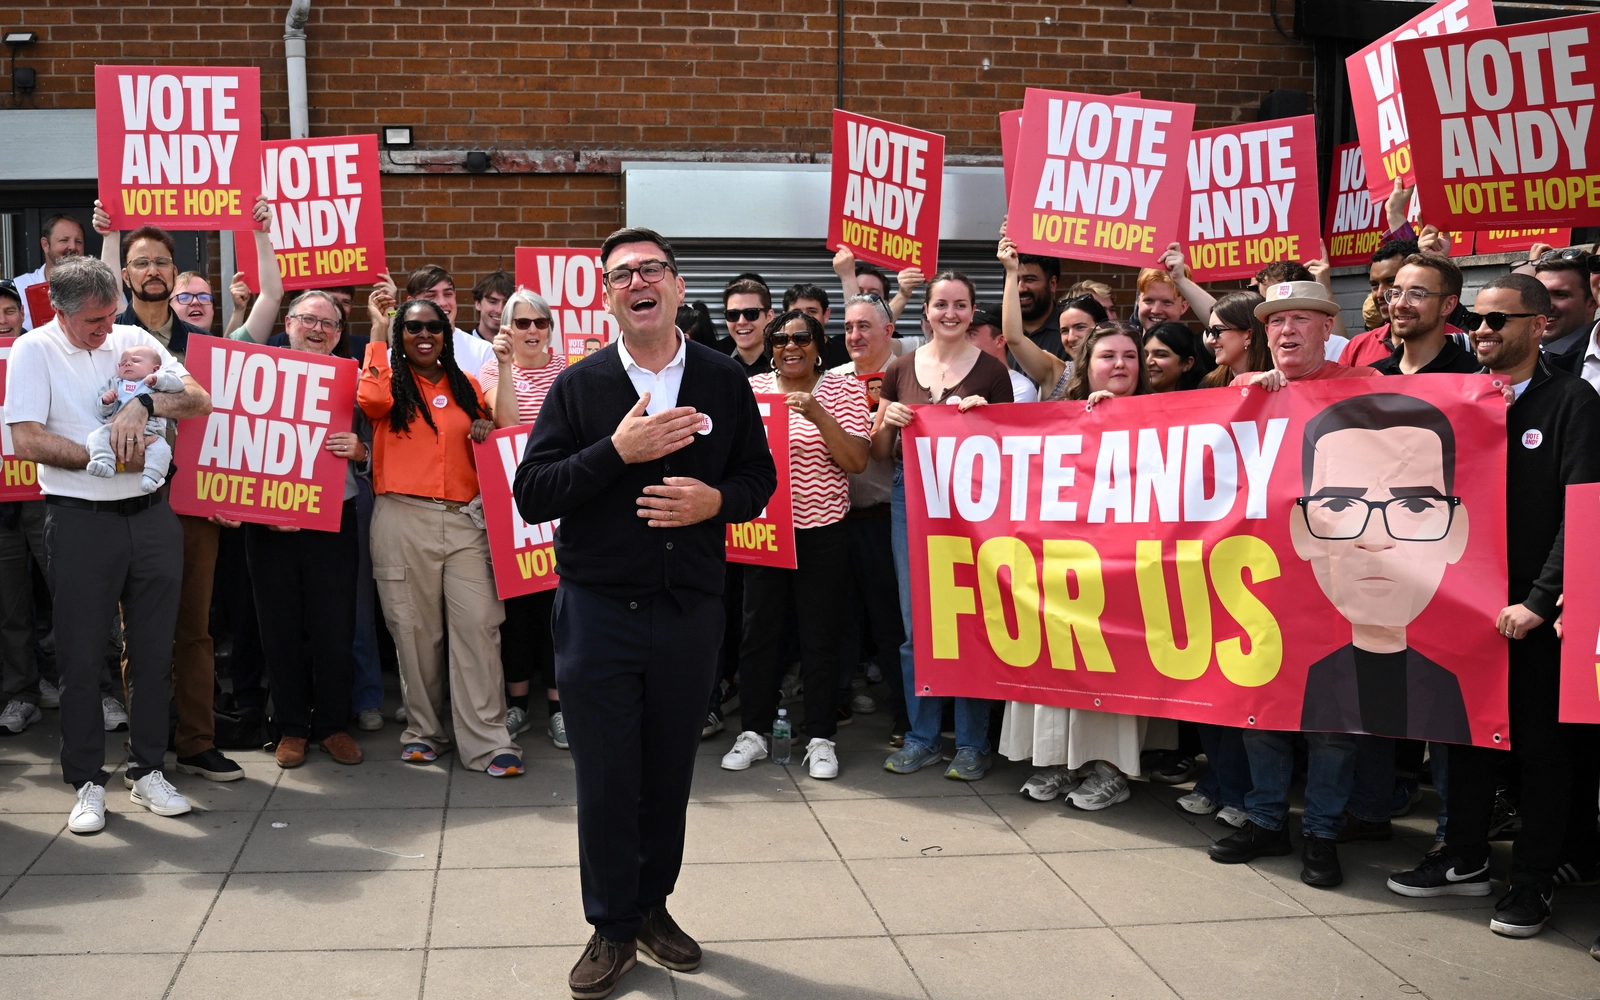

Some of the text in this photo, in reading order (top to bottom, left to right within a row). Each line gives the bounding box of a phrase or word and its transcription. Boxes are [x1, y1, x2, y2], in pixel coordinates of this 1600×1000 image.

[1423, 27, 1595, 115] VOTE
[118, 74, 240, 132] VOTE
[847, 120, 928, 191] VOTE
[1047, 98, 1172, 167] VOTE
[1441, 104, 1594, 179] ANDY
[121, 134, 238, 185] ANDY
[261, 143, 362, 201] VOTE
[1186, 125, 1296, 191] VOTE
[1339, 145, 1366, 192] VO
[1382, 144, 1411, 181] VO
[122, 189, 242, 216] VOTE HOPE
[843, 172, 925, 237] ANDY
[1034, 158, 1163, 221] ANDY
[1188, 182, 1295, 241] ANDY
[1332, 189, 1384, 234] ANDY
[1444, 181, 1518, 215] VOTE
[1524, 174, 1600, 211] HOPE
[842, 219, 878, 252] VOTE
[881, 231, 922, 266] HOPE
[1032, 213, 1157, 254] VOTE HOPE
[1189, 235, 1300, 270] VOTE HOPE
[1330, 230, 1383, 257] VOTE HOPE
[275, 247, 368, 279] OTE HOPE
[536, 255, 603, 308] VO
[568, 339, 584, 348] VOTE
[568, 347, 584, 355] ANDY
[211, 346, 336, 424] VOTE
[198, 412, 328, 480] ANDY
[1525, 432, 1540, 440] VOTE
[4, 459, 38, 486] HO
[196, 470, 322, 514] VOTE HOPE
[915, 417, 1289, 524] VOTE ANDY
[731, 522, 778, 552] HOPE
[516, 546, 558, 580] VOT
[926, 534, 1283, 687] FOR US
